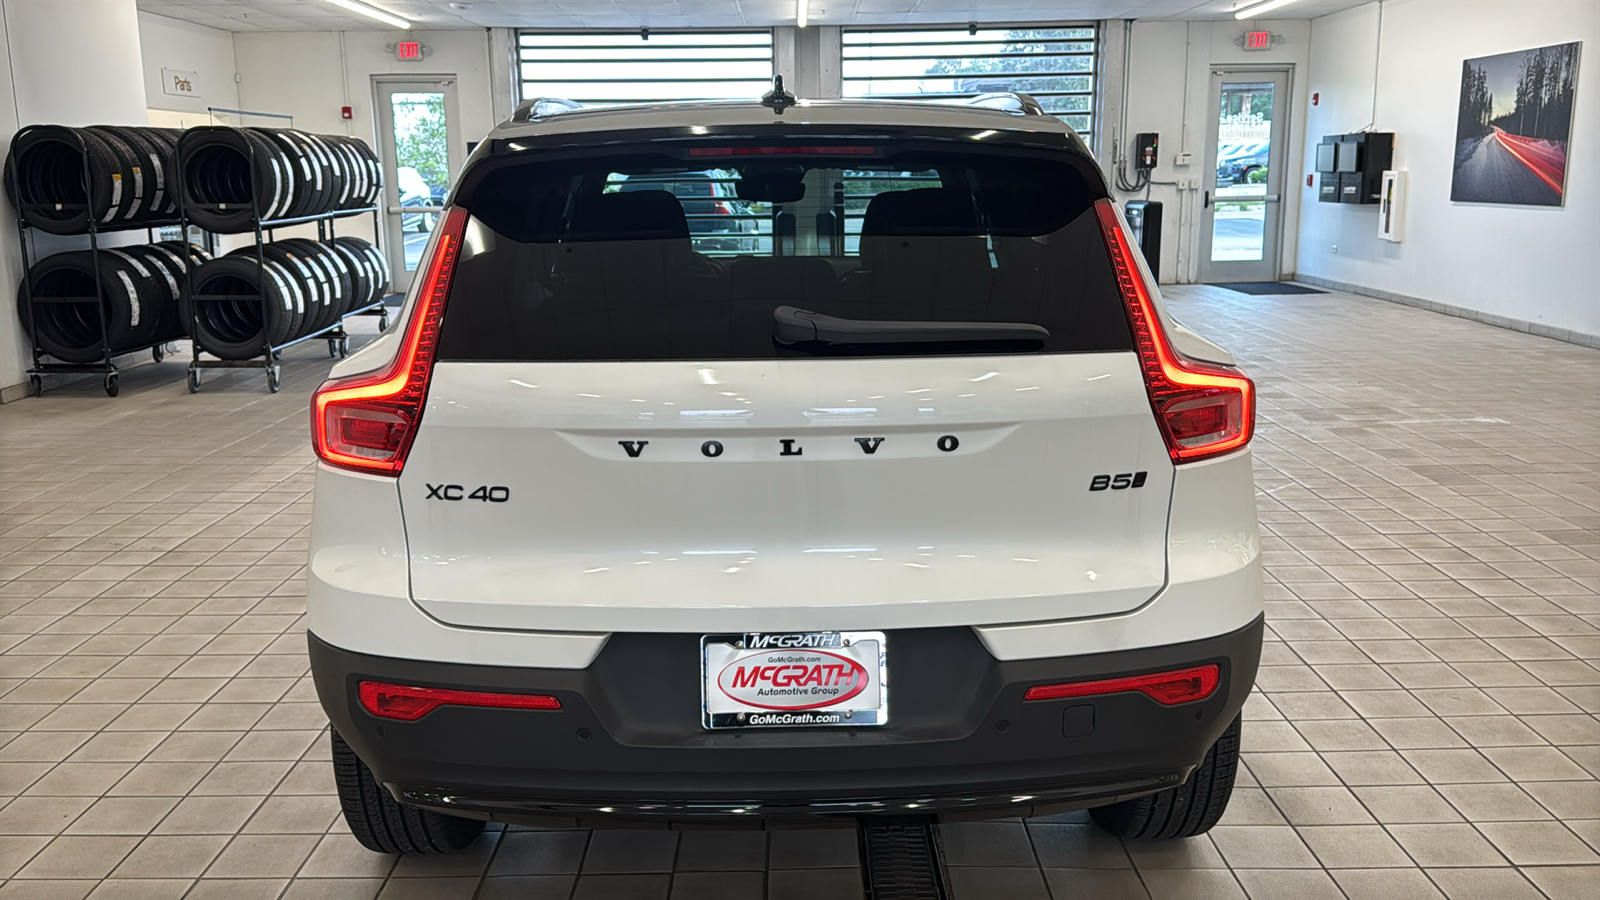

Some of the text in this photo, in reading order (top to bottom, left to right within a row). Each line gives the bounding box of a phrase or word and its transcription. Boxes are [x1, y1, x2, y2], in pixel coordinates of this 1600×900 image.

[1249, 31, 1268, 47] EXIT
[399, 42, 418, 58] EXIT
[174, 75, 192, 92] Parts
[618, 434, 960, 458] VOLVO
[767, 656, 821, 664] GoMcGrath.com
[757, 686, 839, 697] Automotive Group
[749, 713, 840, 725] GoMcGrath.com
